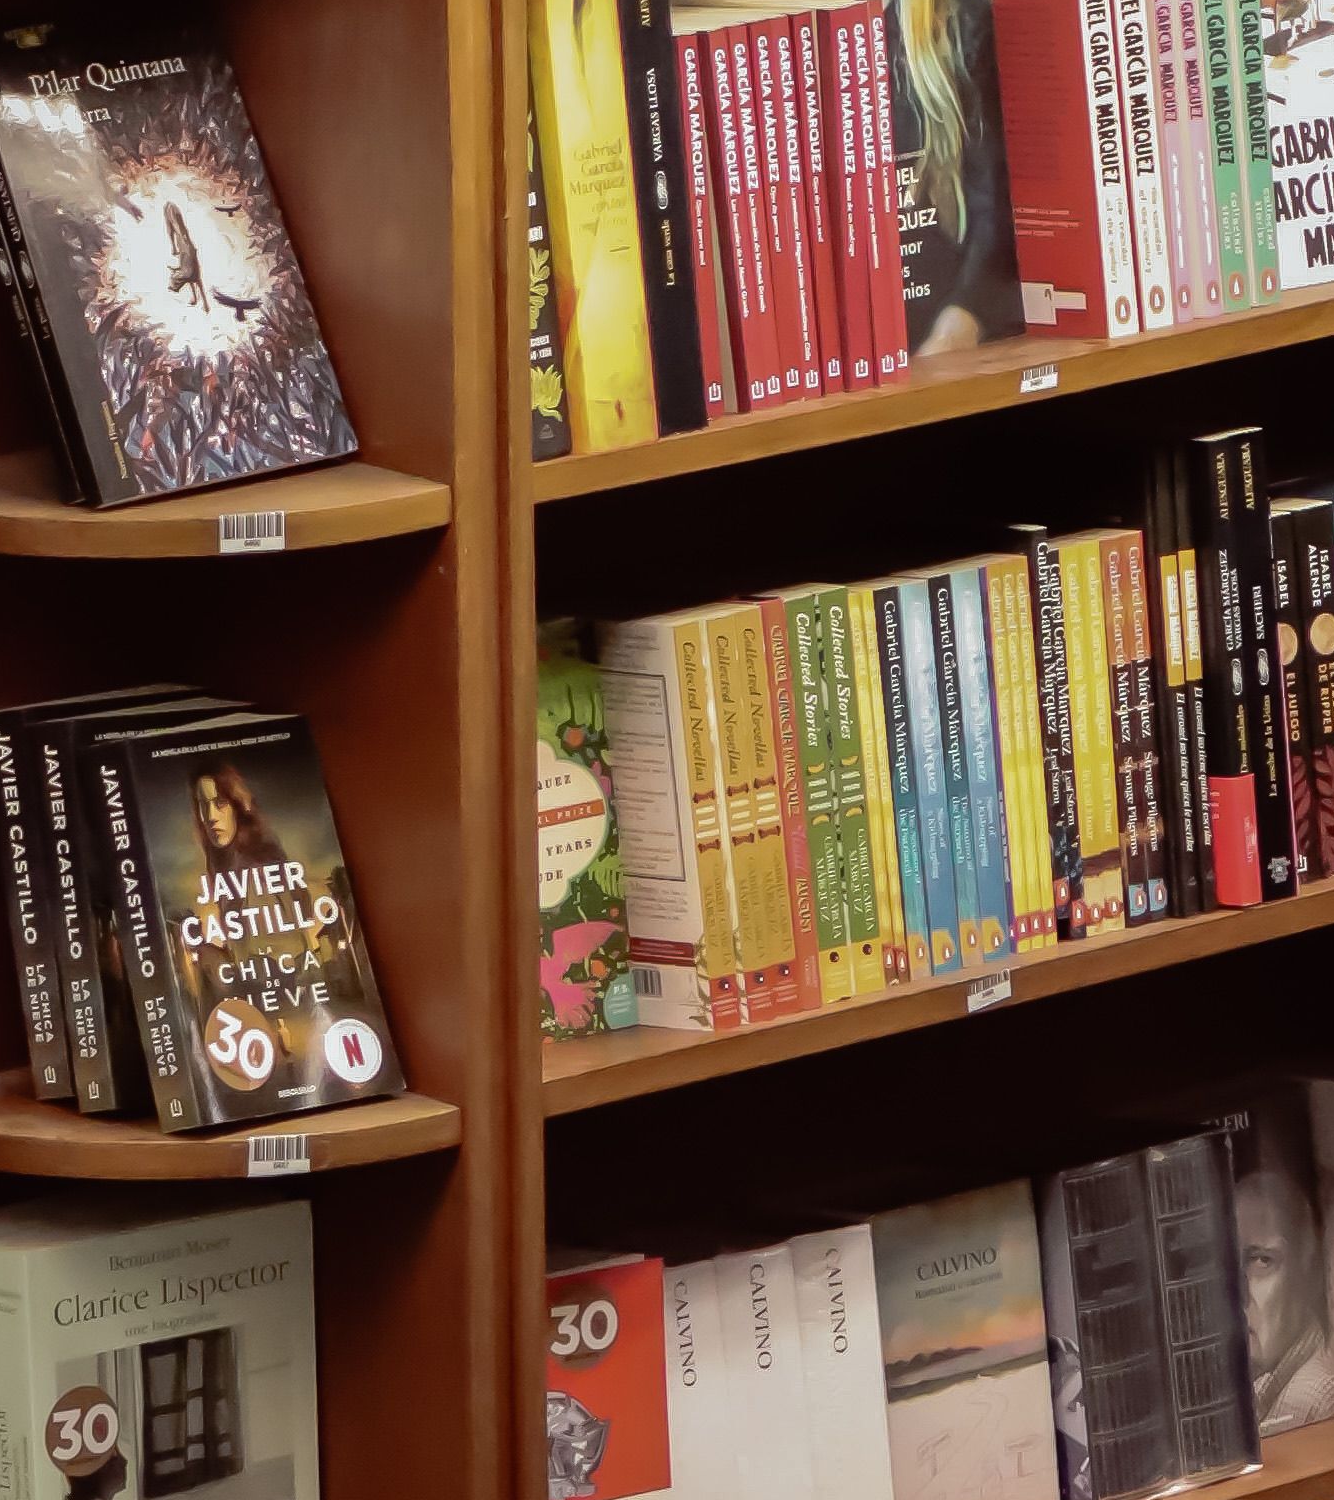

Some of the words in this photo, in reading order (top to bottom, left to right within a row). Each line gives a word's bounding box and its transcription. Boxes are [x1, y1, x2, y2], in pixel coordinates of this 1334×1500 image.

[28, 74, 82, 100] Pilar
[86, 56, 188, 90] Quintana
[734, 43, 753, 106] GARCÍA
[757, 35, 774, 98] GARCÍA
[778, 36, 795, 99] GARCÍA
[800, 26, 817, 90] GARCÍA
[837, 27, 854, 90] GARCÍA
[853, 23, 871, 87] GARCÍA
[872, 17, 889, 77] GARCÍA
[1089, 31, 1114, 98] GARCÍA
[684, 48, 702, 111] GARCÍA
[714, 49, 733, 111] GARCÍA
[741, 107, 759, 190] MÁRQUEZ
[763, 100, 780, 182] MÁRQUEZ
[782, 101, 801, 184] MÁRQUEZ
[805, 90, 823, 174] MÁRQUEZ
[840, 91, 857, 174] MÁRQUEZ
[858, 87, 877, 169] MÁRQUEZ
[877, 81, 894, 163] MÁRQUEZ
[689, 113, 706, 196] MÁRQUEZ
[721, 113, 741, 196] MÁRQUEZ
[1307, 544, 1322, 608] ALLENDE
[1319, 549, 1332, 599] ISABEL
[830, 606, 846, 681] Collected
[1252, 585, 1265, 640] SACHERI
[796, 613, 814, 689] Collected
[1318, 664, 1328, 682] DE
[803, 691, 819, 748] Stories
[836, 683, 852, 741] Stories
[1322, 684, 1332, 735] RIPPER
[44, 744, 67, 831] JAVIER
[56, 839, 83, 960] CASTILLO
[101, 765, 130, 852] JAVIER
[121, 859, 156, 979] CASTILLO
[546, 837, 593, 856] YEARS
[9, 824, 38, 946] CASTILLO
[196, 860, 308, 905] JAVIER
[181, 895, 340, 947] CASTILLO
[25, 966, 37, 988] DE
[35, 963, 46, 988] LA
[71, 980, 81, 1002] DE
[79, 979, 90, 1002] LA
[218, 949, 321, 985] CHICA
[29, 992, 44, 1044] NIEVE
[38, 991, 54, 1044] CHICA
[75, 1007, 88, 1058] NIEVE
[83, 1006, 98, 1058] CHICA
[144, 999, 157, 1022] DE
[155, 996, 166, 1021] LA
[149, 1024, 167, 1078] NIEVE
[160, 1024, 178, 1076] CHICA
[208, 1009, 276, 1081] 30
[54, 1282, 149, 1328] Clarice
[158, 1259, 291, 1311] Lispector
[916, 1244, 998, 1284] CALVINO
[550, 1299, 619, 1357] 30
[750, 1262, 772, 1372] CALVINO
[824, 1247, 849, 1356] CALVINO
[673, 1279, 698, 1388] CALVINO
[51, 1403, 121, 1460] 30
